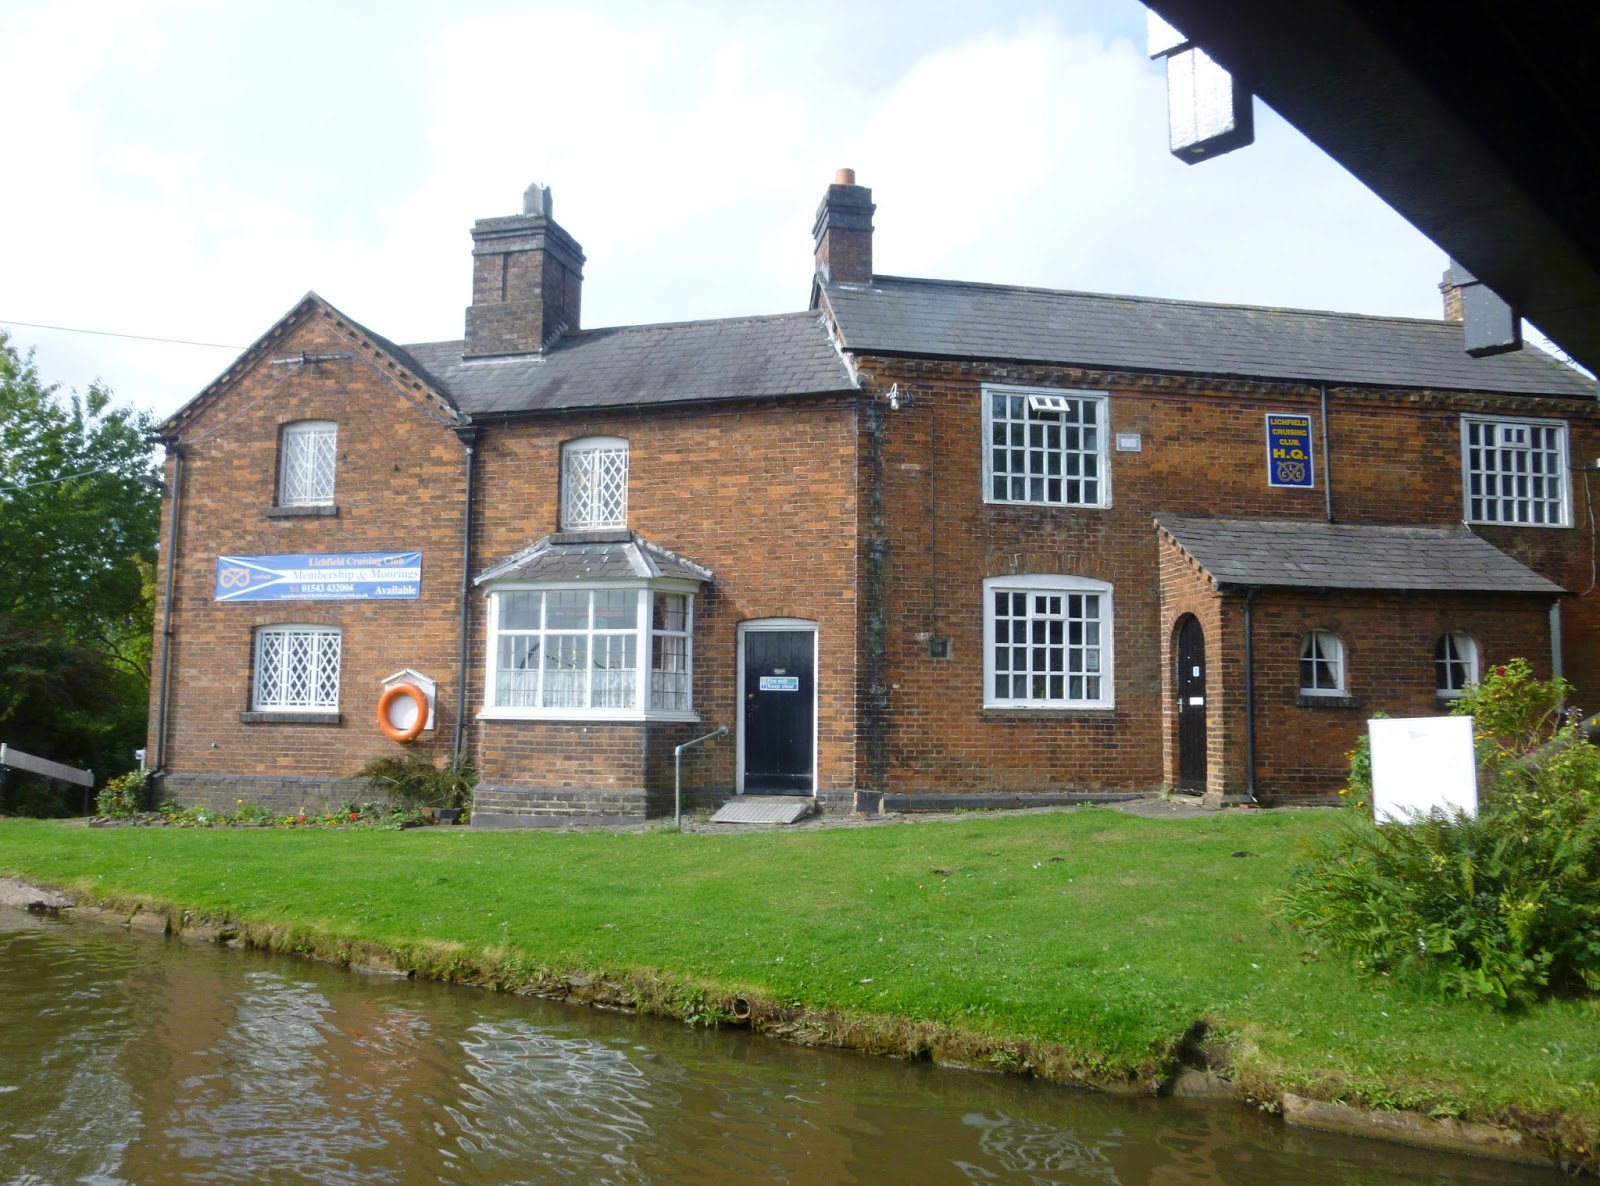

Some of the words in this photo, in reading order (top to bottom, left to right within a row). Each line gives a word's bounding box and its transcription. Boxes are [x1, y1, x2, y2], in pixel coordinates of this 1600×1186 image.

[1270, 418, 1308, 427] LICHFIELD
[1272, 428, 1308, 436] CRUISING
[1279, 438, 1301, 446] CLUB.
[1272, 448, 1309, 460] H.Q.
[309, 557, 345, 566] Lichfield
[346, 556, 382, 567] Cruising
[383, 556, 405, 565] Club
[293, 569, 354, 581] Membership
[357, 571, 367, 580] &
[371, 569, 419, 580] Moorings
[301, 584, 325, 592] 01543
[326, 583, 354, 592] 432004
[375, 585, 417, 595] Available
